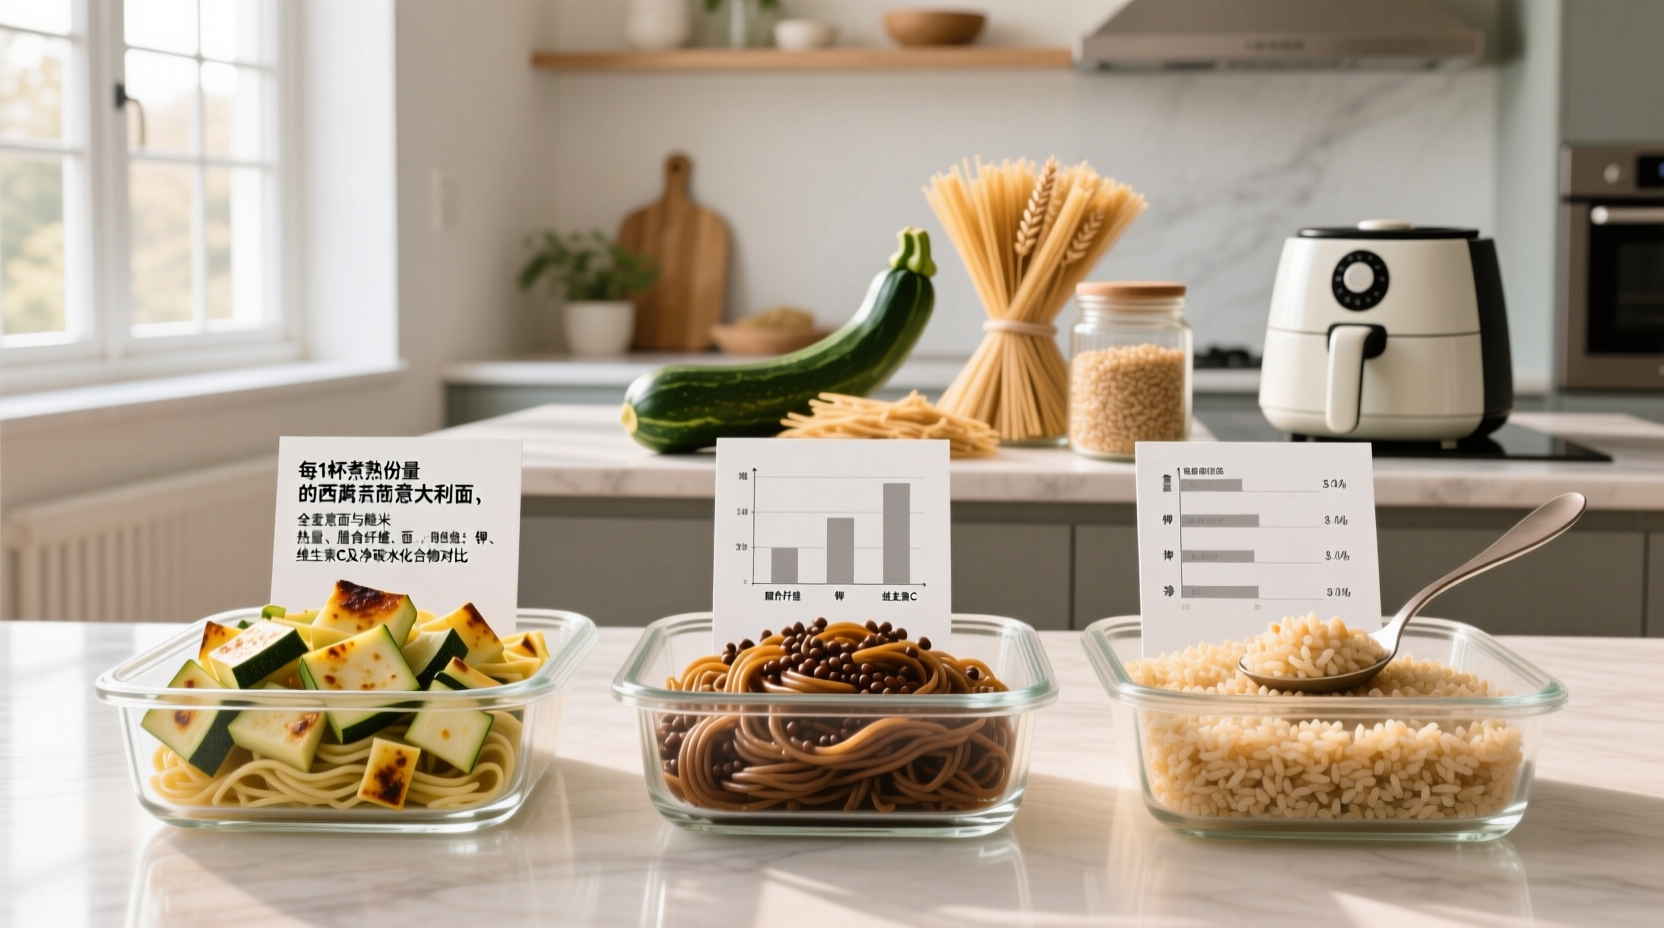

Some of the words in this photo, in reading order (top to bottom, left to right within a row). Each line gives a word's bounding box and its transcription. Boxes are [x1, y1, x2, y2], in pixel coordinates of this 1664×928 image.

[298, 460, 421, 481] 每1杯煮熟份量
